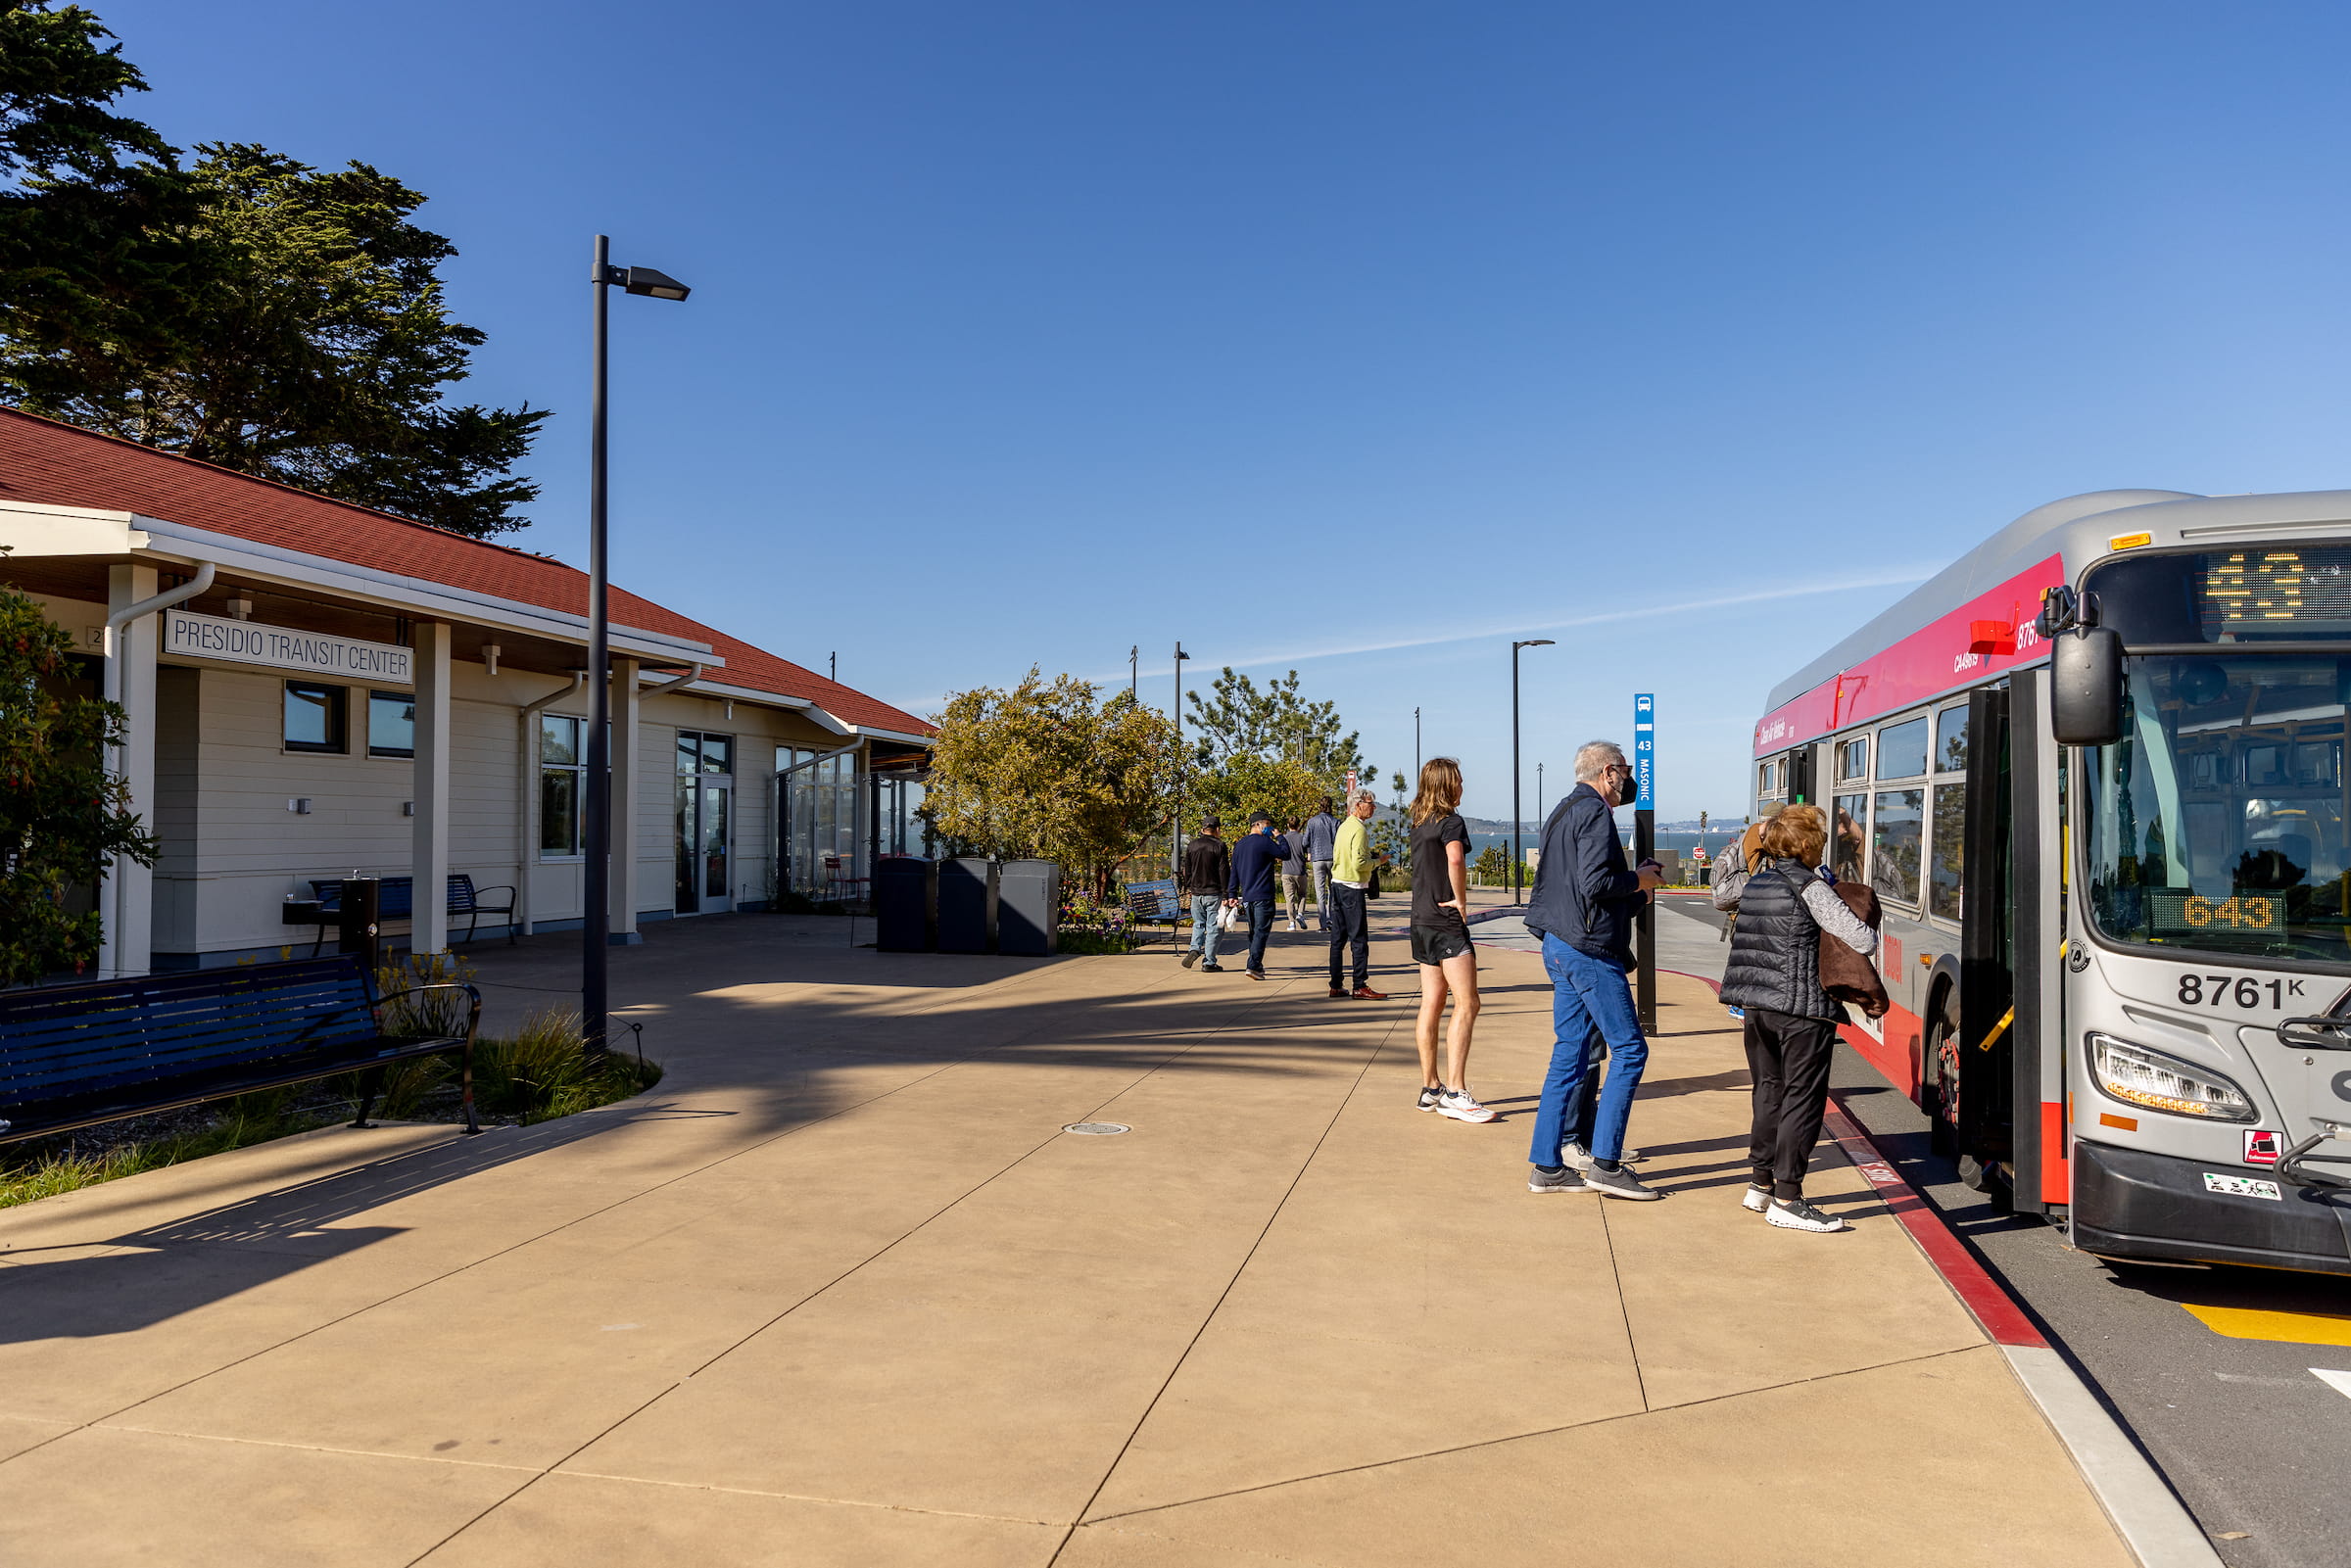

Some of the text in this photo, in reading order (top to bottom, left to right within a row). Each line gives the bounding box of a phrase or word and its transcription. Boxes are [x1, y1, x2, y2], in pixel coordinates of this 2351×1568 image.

[2205, 552, 2304, 618] 43
[174, 619, 408, 676] PRESIDIO TRANSIT CENTER
[1637, 740, 1652, 751] 43
[1640, 758, 1650, 801] MASONIC
[2184, 895, 2273, 928] 643
